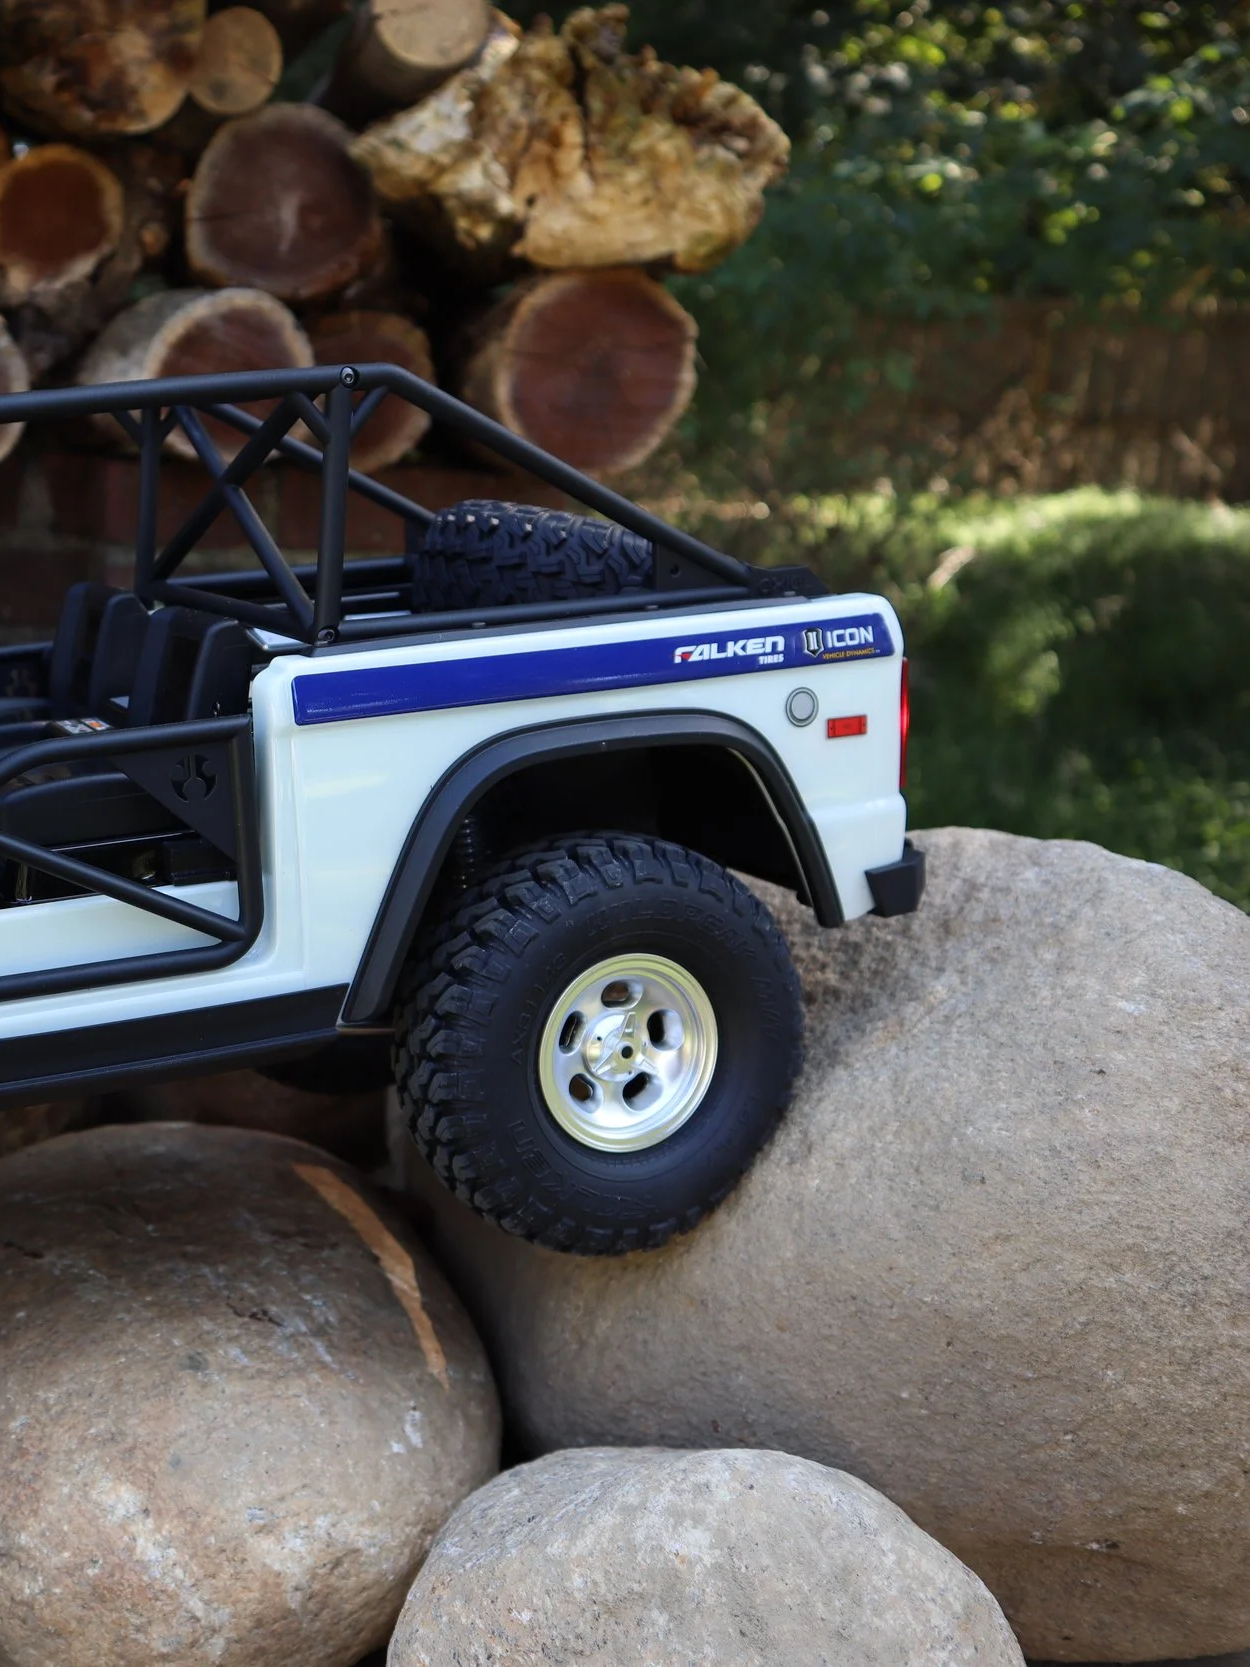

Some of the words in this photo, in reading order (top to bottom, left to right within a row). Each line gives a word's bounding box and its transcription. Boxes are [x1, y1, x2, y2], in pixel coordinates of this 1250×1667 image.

[827, 625, 874, 648] ICON
[674, 635, 786, 664] FALKEN
[822, 650, 845, 660] VEHICLE
[846, 647, 876, 657] DYNAMICS
[758, 653, 785, 665] TIRES
